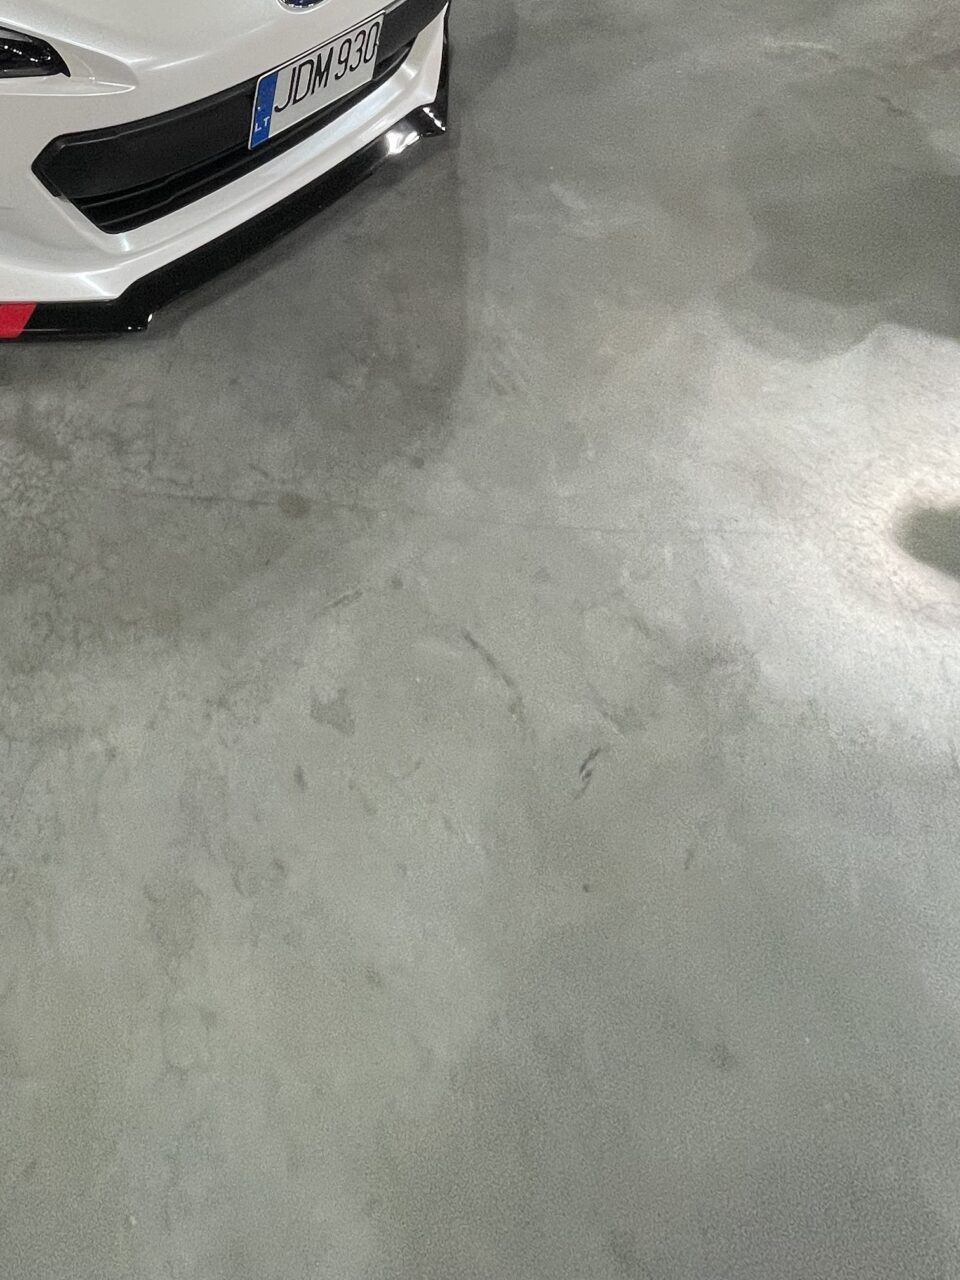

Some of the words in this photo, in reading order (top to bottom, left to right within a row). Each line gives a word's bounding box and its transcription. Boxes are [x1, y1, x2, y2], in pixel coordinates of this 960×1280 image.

[273, 46, 334, 113] JDM
[334, 21, 381, 81] 930
[253, 116, 271, 133] LT
